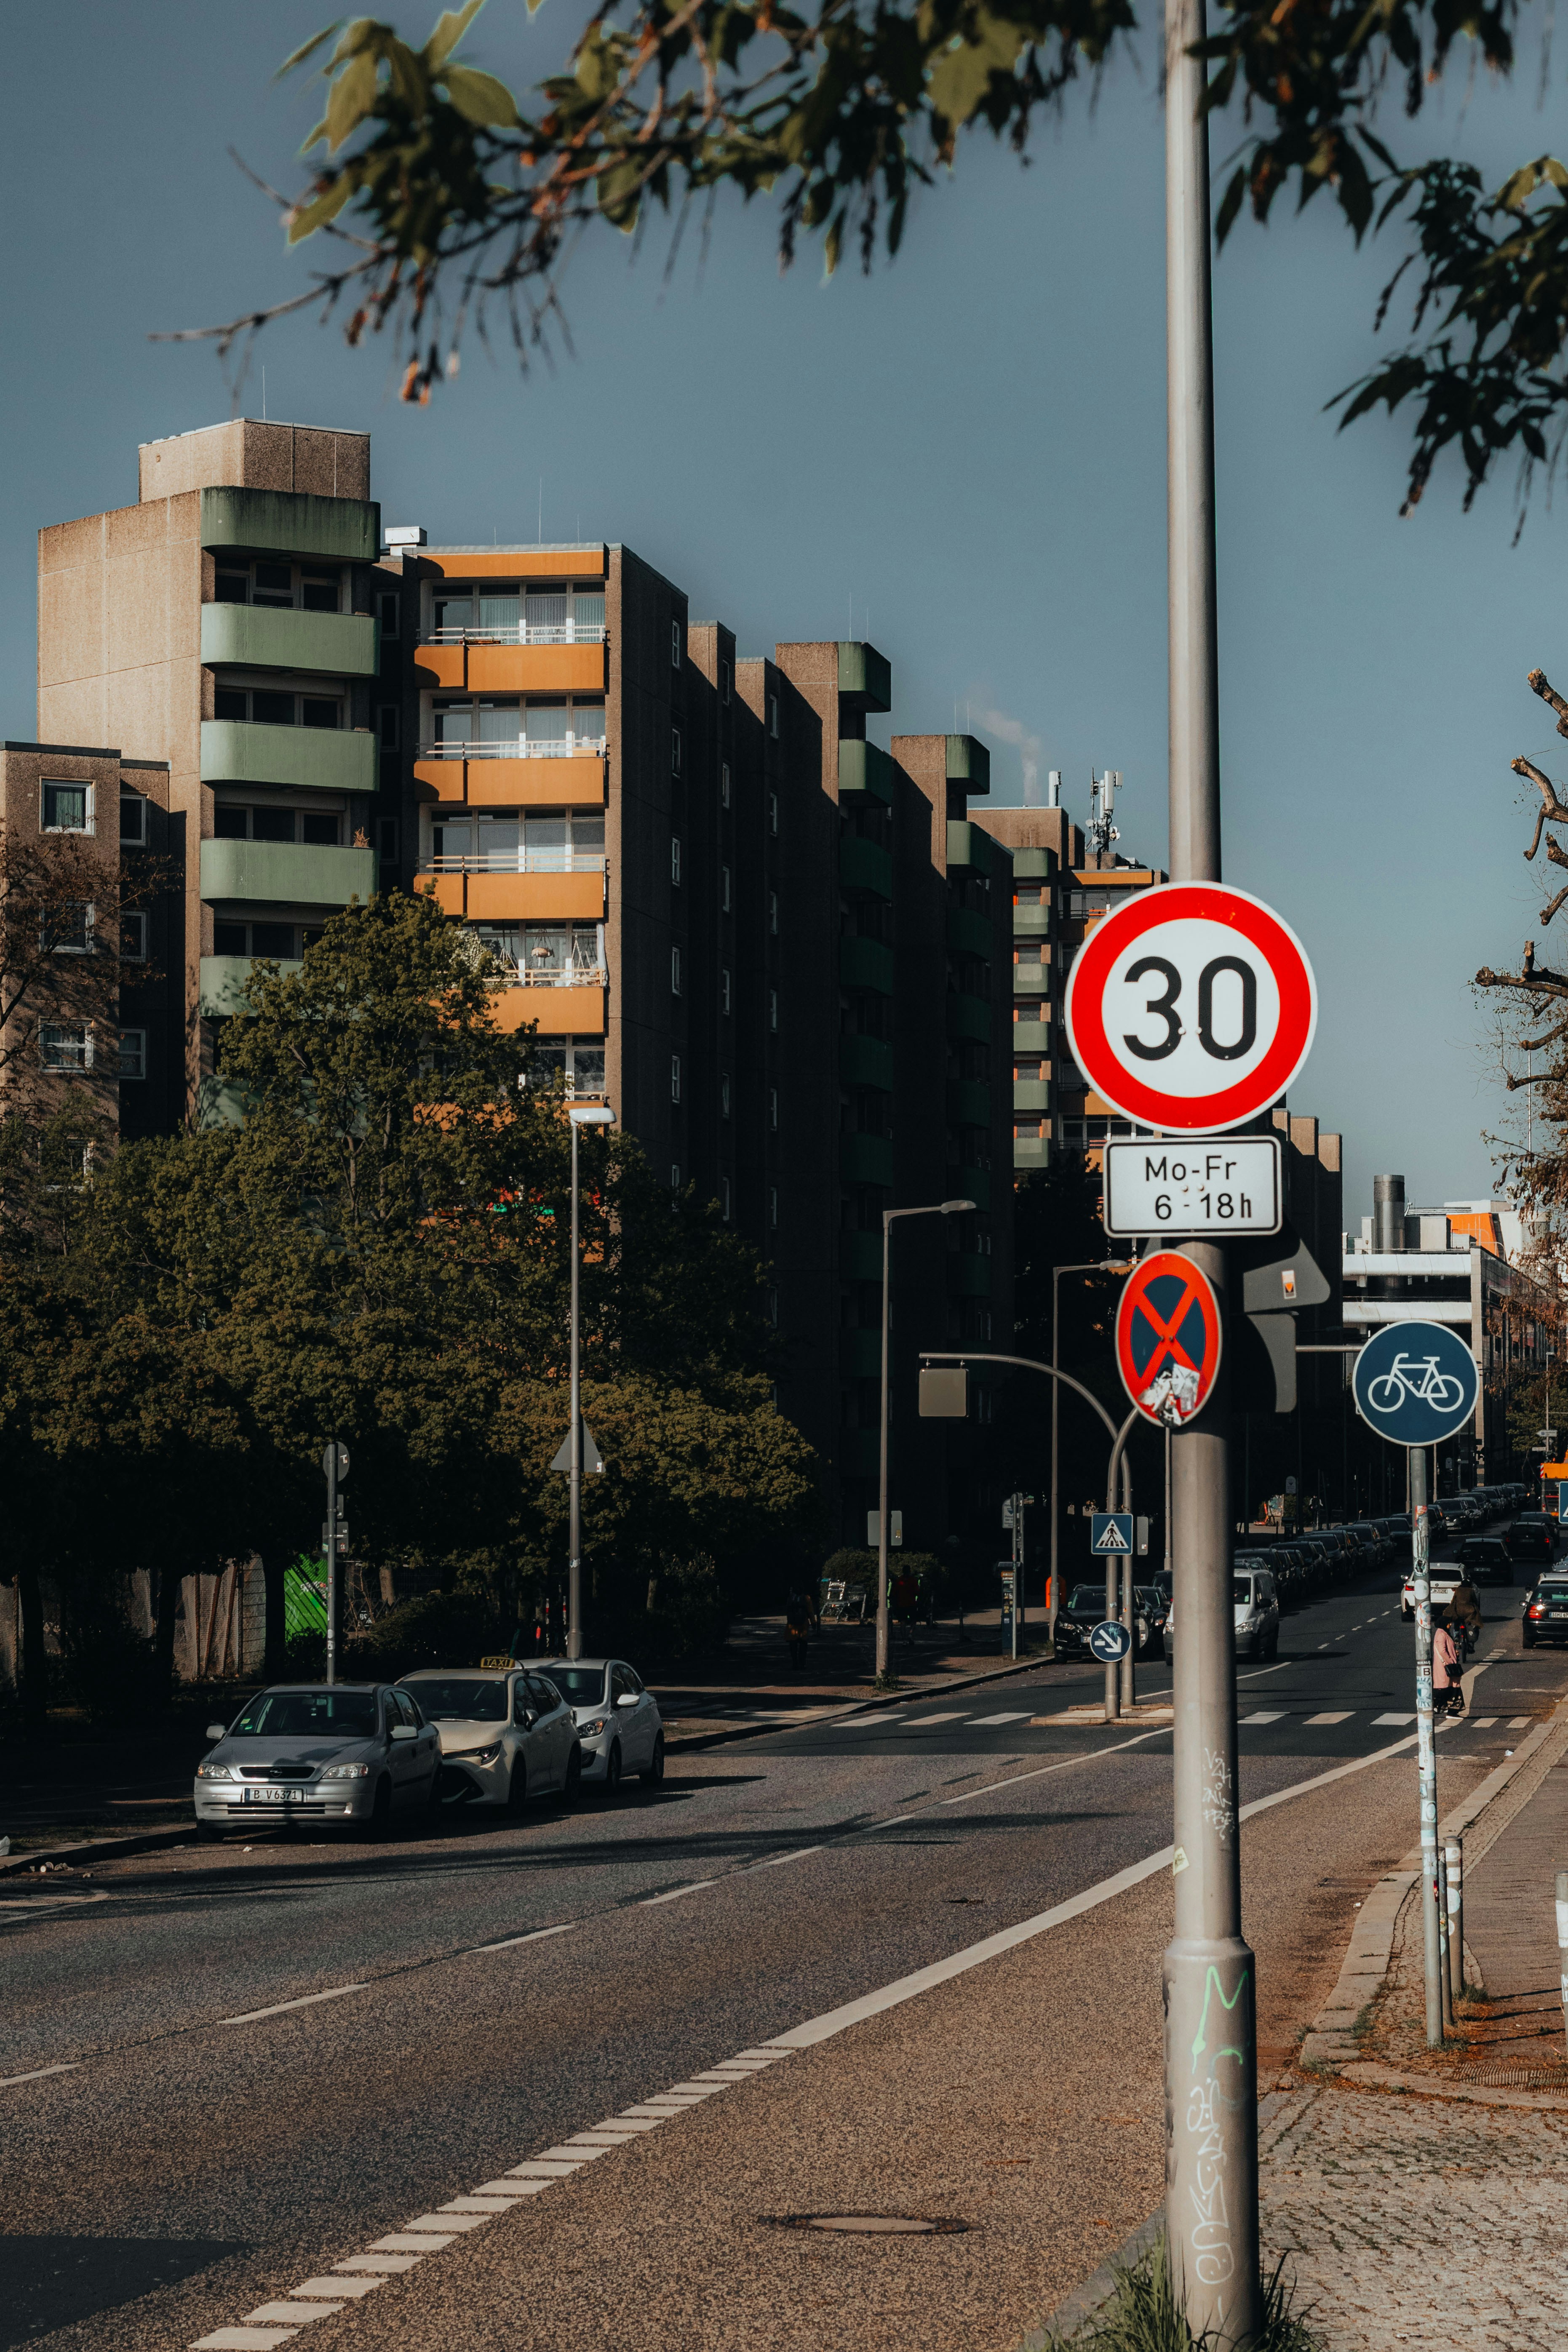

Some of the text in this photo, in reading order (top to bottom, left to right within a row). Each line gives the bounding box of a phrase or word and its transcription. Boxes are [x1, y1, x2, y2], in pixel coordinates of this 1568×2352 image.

[1123, 956, 1257, 1061] 30
[1146, 1155, 1237, 1181] Mo-Fr
[486, 1658, 508, 1666] TAXI
[1423, 1668, 1431, 1676] B
[254, 1790, 259, 1799] B
